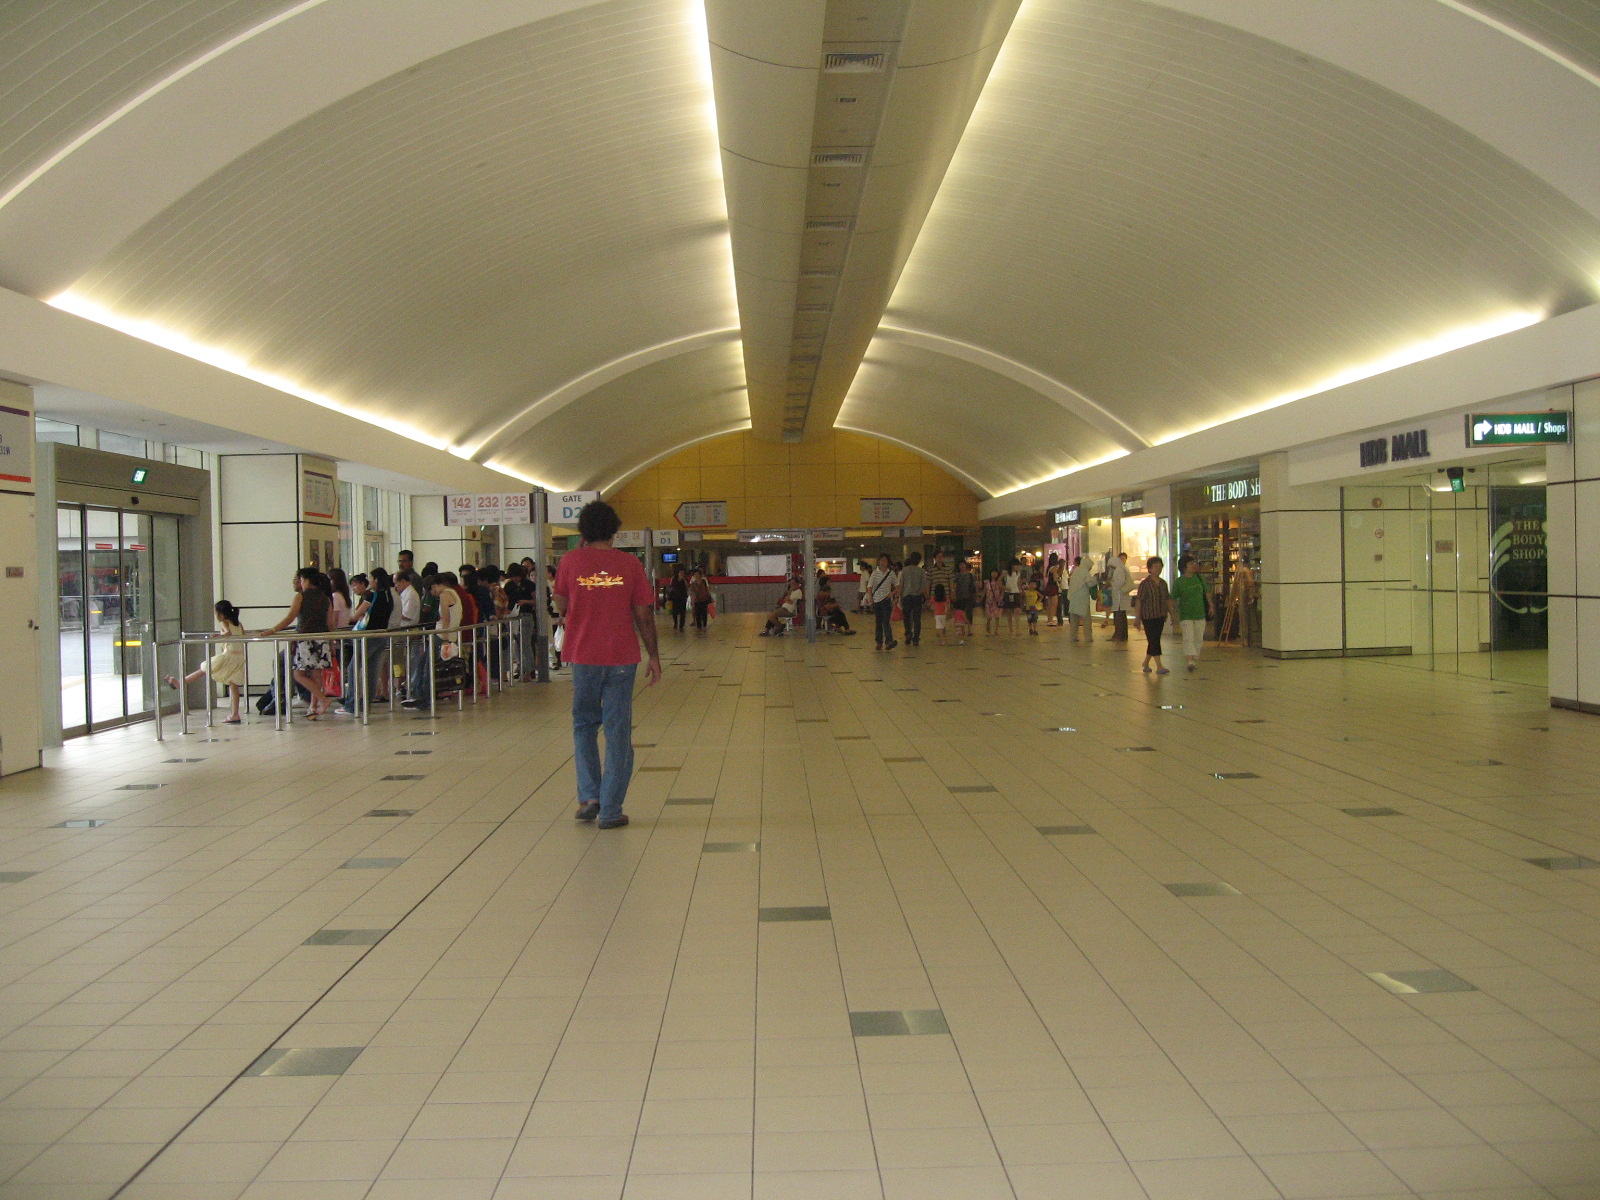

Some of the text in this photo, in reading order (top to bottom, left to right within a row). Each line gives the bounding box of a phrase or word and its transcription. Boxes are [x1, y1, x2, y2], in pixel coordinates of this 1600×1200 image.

[1494, 423, 1511, 435] HDB
[1514, 422, 1535, 434] MALL
[1544, 421, 1565, 435] Shops
[1360, 429, 1430, 468] HDB MALL
[1211, 483, 1227, 502] THE
[1228, 479, 1248, 500] BODY
[452, 497, 471, 508] 142
[478, 496, 499, 507] 232
[505, 495, 527, 507] 235
[562, 495, 582, 503] GATE
[1515, 520, 1540, 530] THE
[1512, 534, 1545, 545] BODY
[1512, 549, 1544, 560] SHOP
